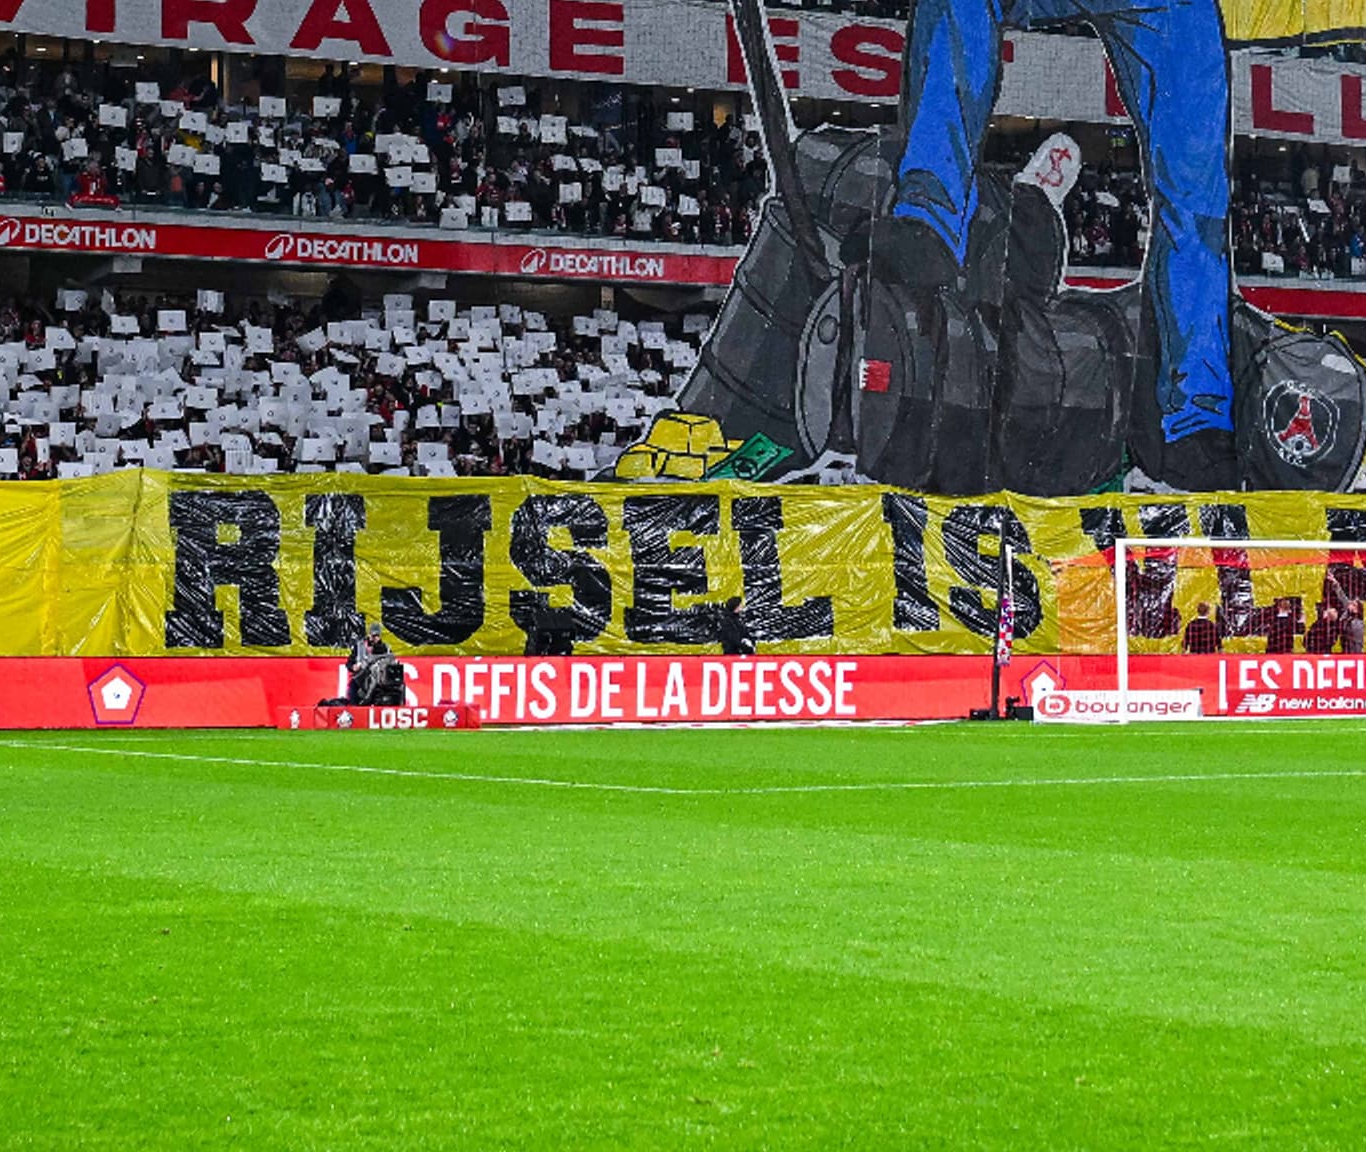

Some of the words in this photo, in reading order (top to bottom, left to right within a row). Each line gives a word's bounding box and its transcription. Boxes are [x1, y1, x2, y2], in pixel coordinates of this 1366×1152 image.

[726, 13, 1015, 97] ES
[24, 222, 157, 250] DECATHLON
[296, 237, 420, 265] DECATHLON
[549, 252, 665, 278] DECATHLON
[165, 489, 835, 648] RIJSEL
[882, 491, 1042, 640] IS
[432, 656, 558, 721] DÉFIS
[568, 661, 625, 719] DE
[636, 660, 690, 718] LA
[700, 653, 859, 717] DÉESSE
[367, 706, 429, 730] LOSC
[1074, 696, 1193, 716] bouanger
[1279, 698, 1314, 710] new
